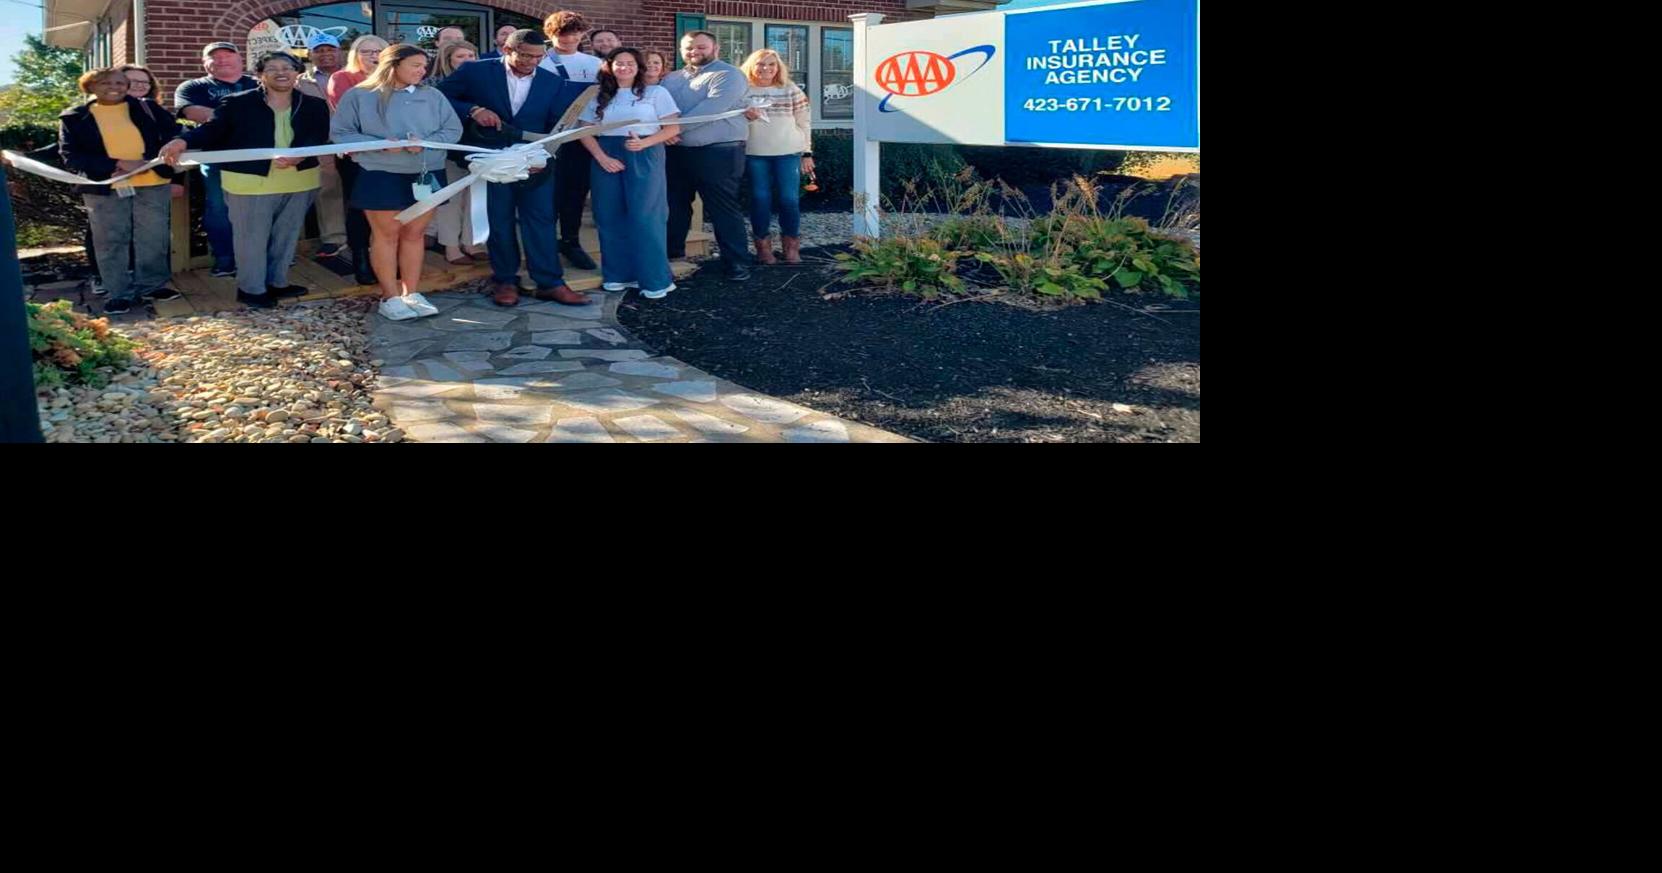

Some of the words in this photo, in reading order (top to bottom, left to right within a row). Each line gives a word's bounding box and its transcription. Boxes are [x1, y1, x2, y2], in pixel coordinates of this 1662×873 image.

[1048, 34, 1140, 54] TALLEY
[1026, 49, 1166, 70] INSURANCE
[878, 51, 953, 96] AAA
[1044, 67, 1143, 85] AGENCY
[1023, 96, 1171, 112] 423-671-7012
